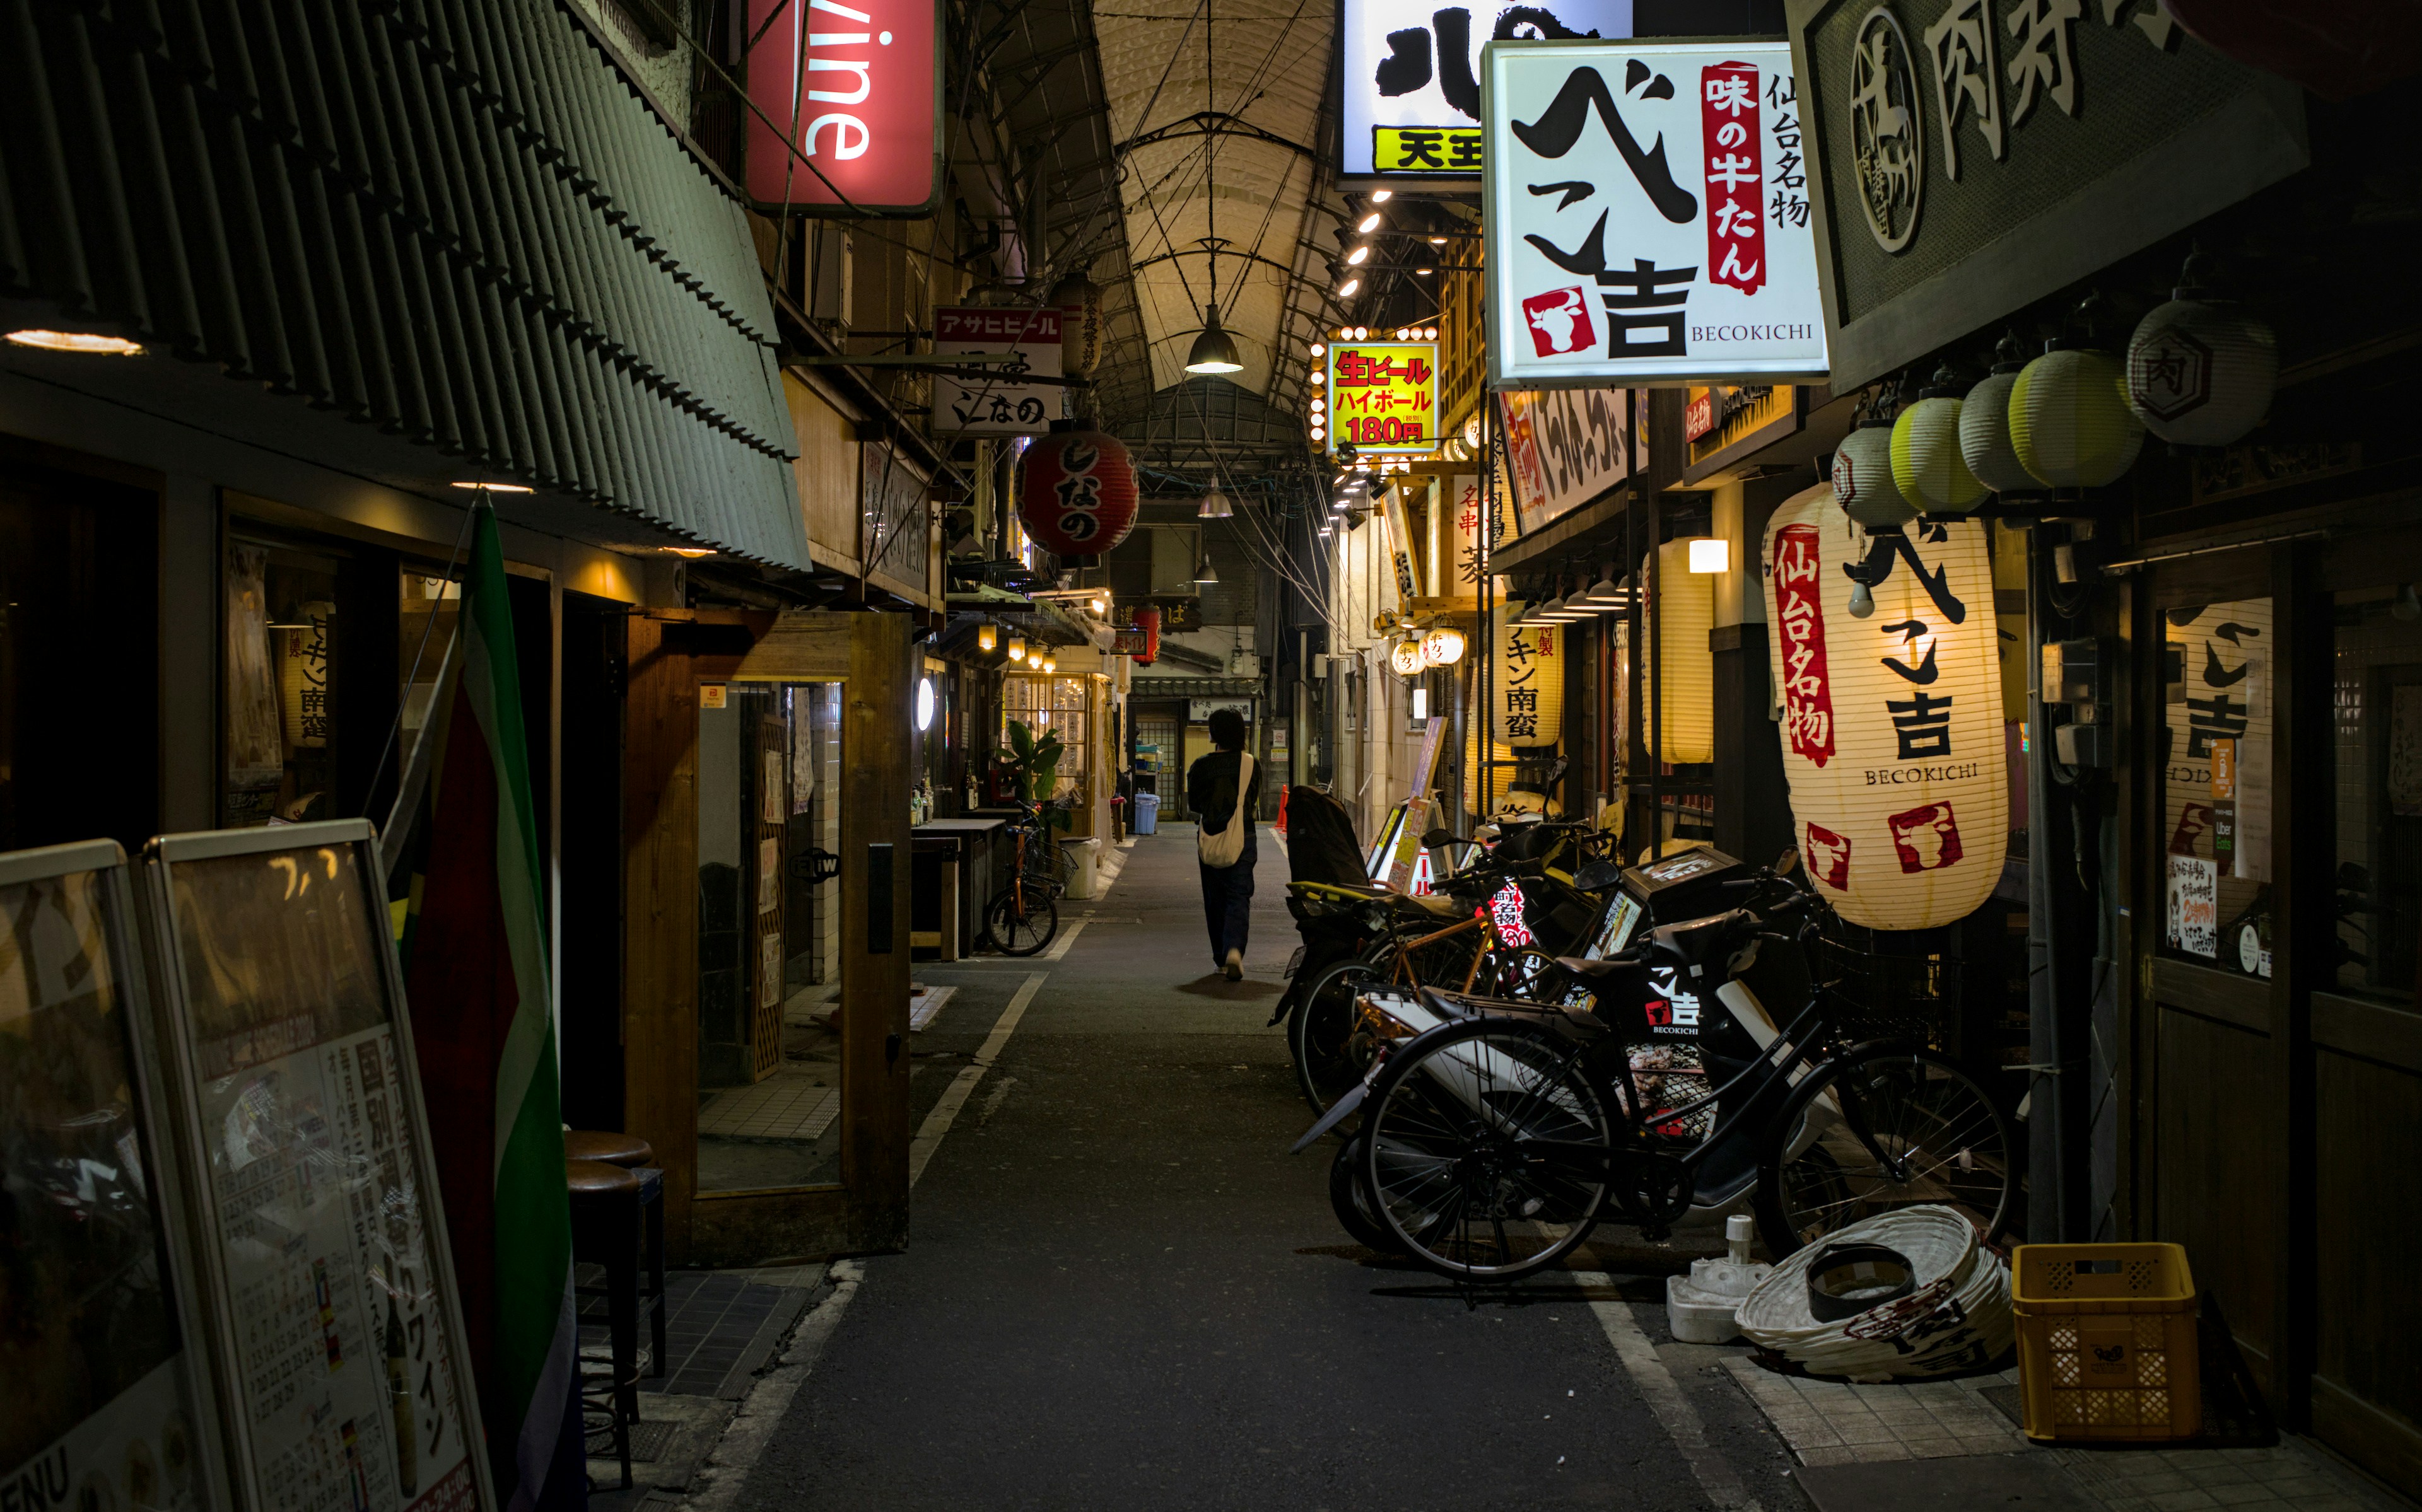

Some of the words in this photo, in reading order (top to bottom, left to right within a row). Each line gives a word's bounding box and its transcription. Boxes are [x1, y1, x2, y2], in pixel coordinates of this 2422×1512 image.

[1765, 74, 1811, 229] 仙台名物
[1705, 75, 1760, 283] 味の牛たん
[1511, 59, 1699, 359] べこ吉
[941, 315, 1058, 335] アサヒビール
[1692, 324, 1811, 342] BECOKICHI
[1336, 351, 1431, 387] 生ビール
[2145, 347, 2187, 396] 肉
[1336, 389, 1432, 414] ハイボール
[1345, 416, 1424, 445] 180円
[1774, 539, 1829, 750] 仙台名物
[1865, 763, 1978, 785] BECOKICHI
[2216, 822, 2232, 835] Uber
[2216, 836, 2232, 851] Eats
[1653, 1026, 1699, 1036] BECOKICHI
